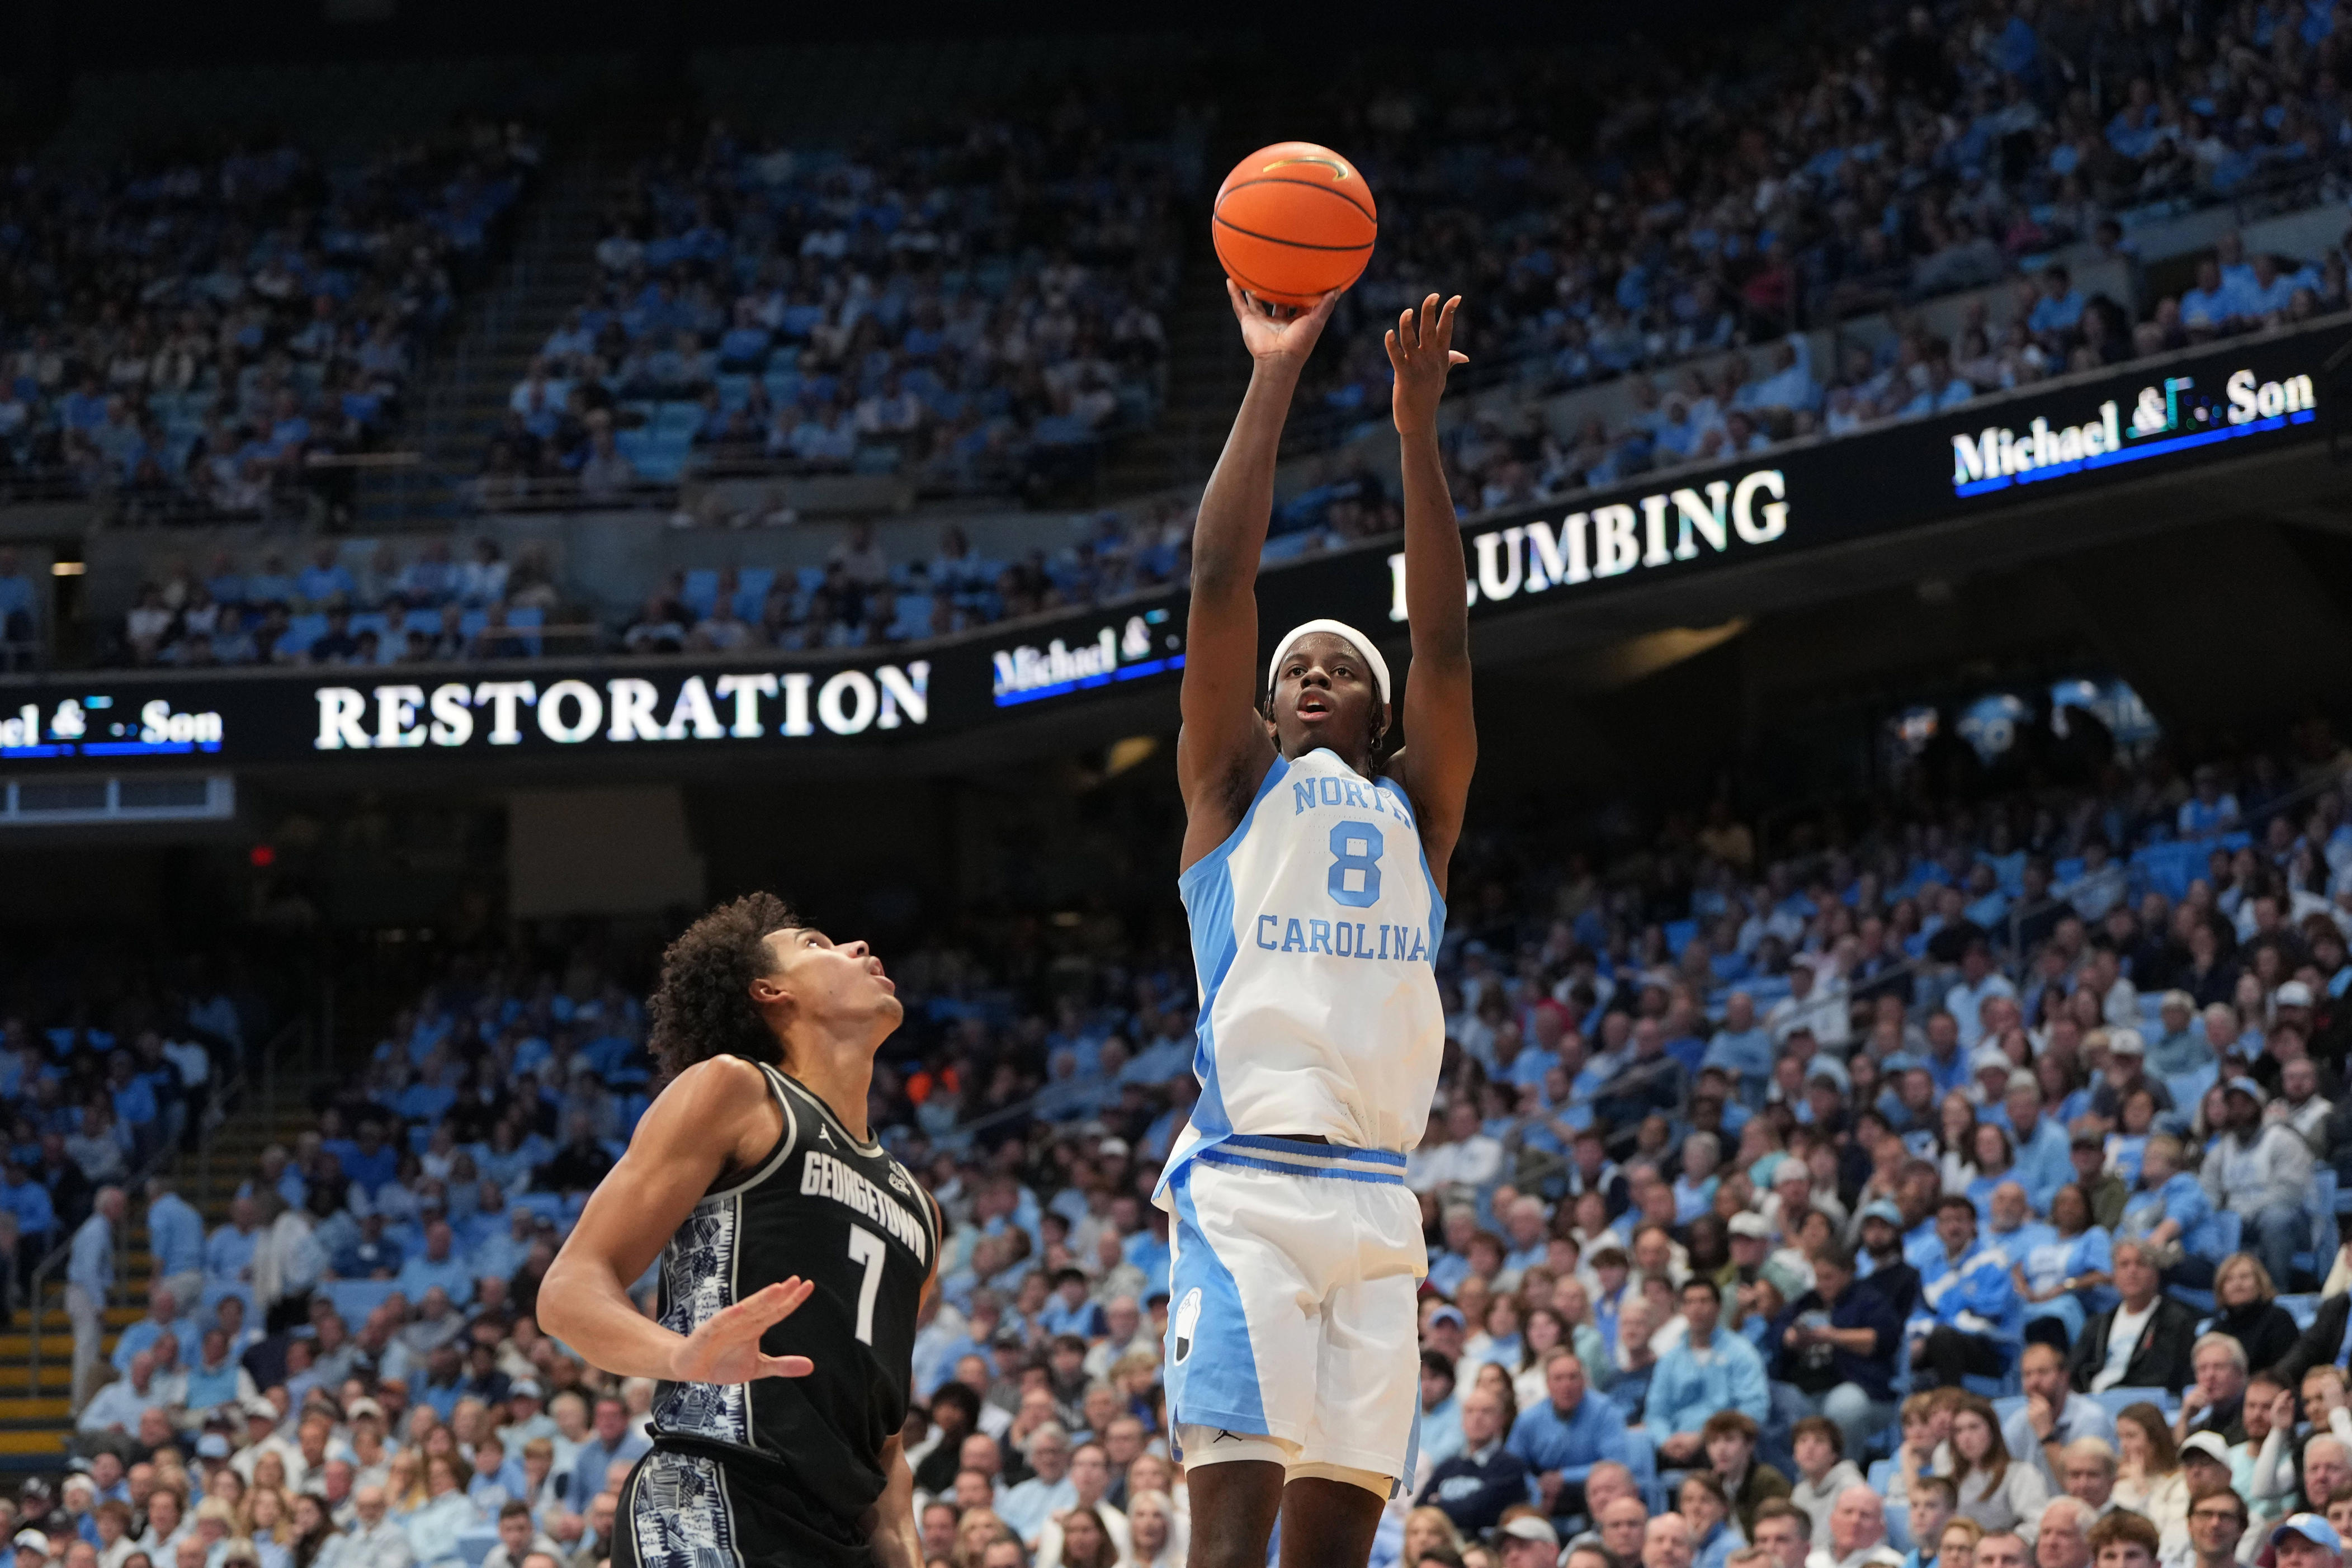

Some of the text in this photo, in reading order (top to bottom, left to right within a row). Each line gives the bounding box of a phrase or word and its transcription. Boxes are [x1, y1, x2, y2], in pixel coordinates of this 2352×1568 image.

[1953, 399, 2122, 487] Michael
[2226, 369, 2316, 426] Son
[1388, 469, 1789, 622] UMBING
[141, 699, 223, 744] Son
[314, 660, 931, 750] RESTORATION
[1328, 820, 1384, 909] 8
[1257, 914, 1429, 962] CAROLINA
[800, 1150, 926, 1267] GEORGETOWN
[848, 1222, 886, 1347] 7
